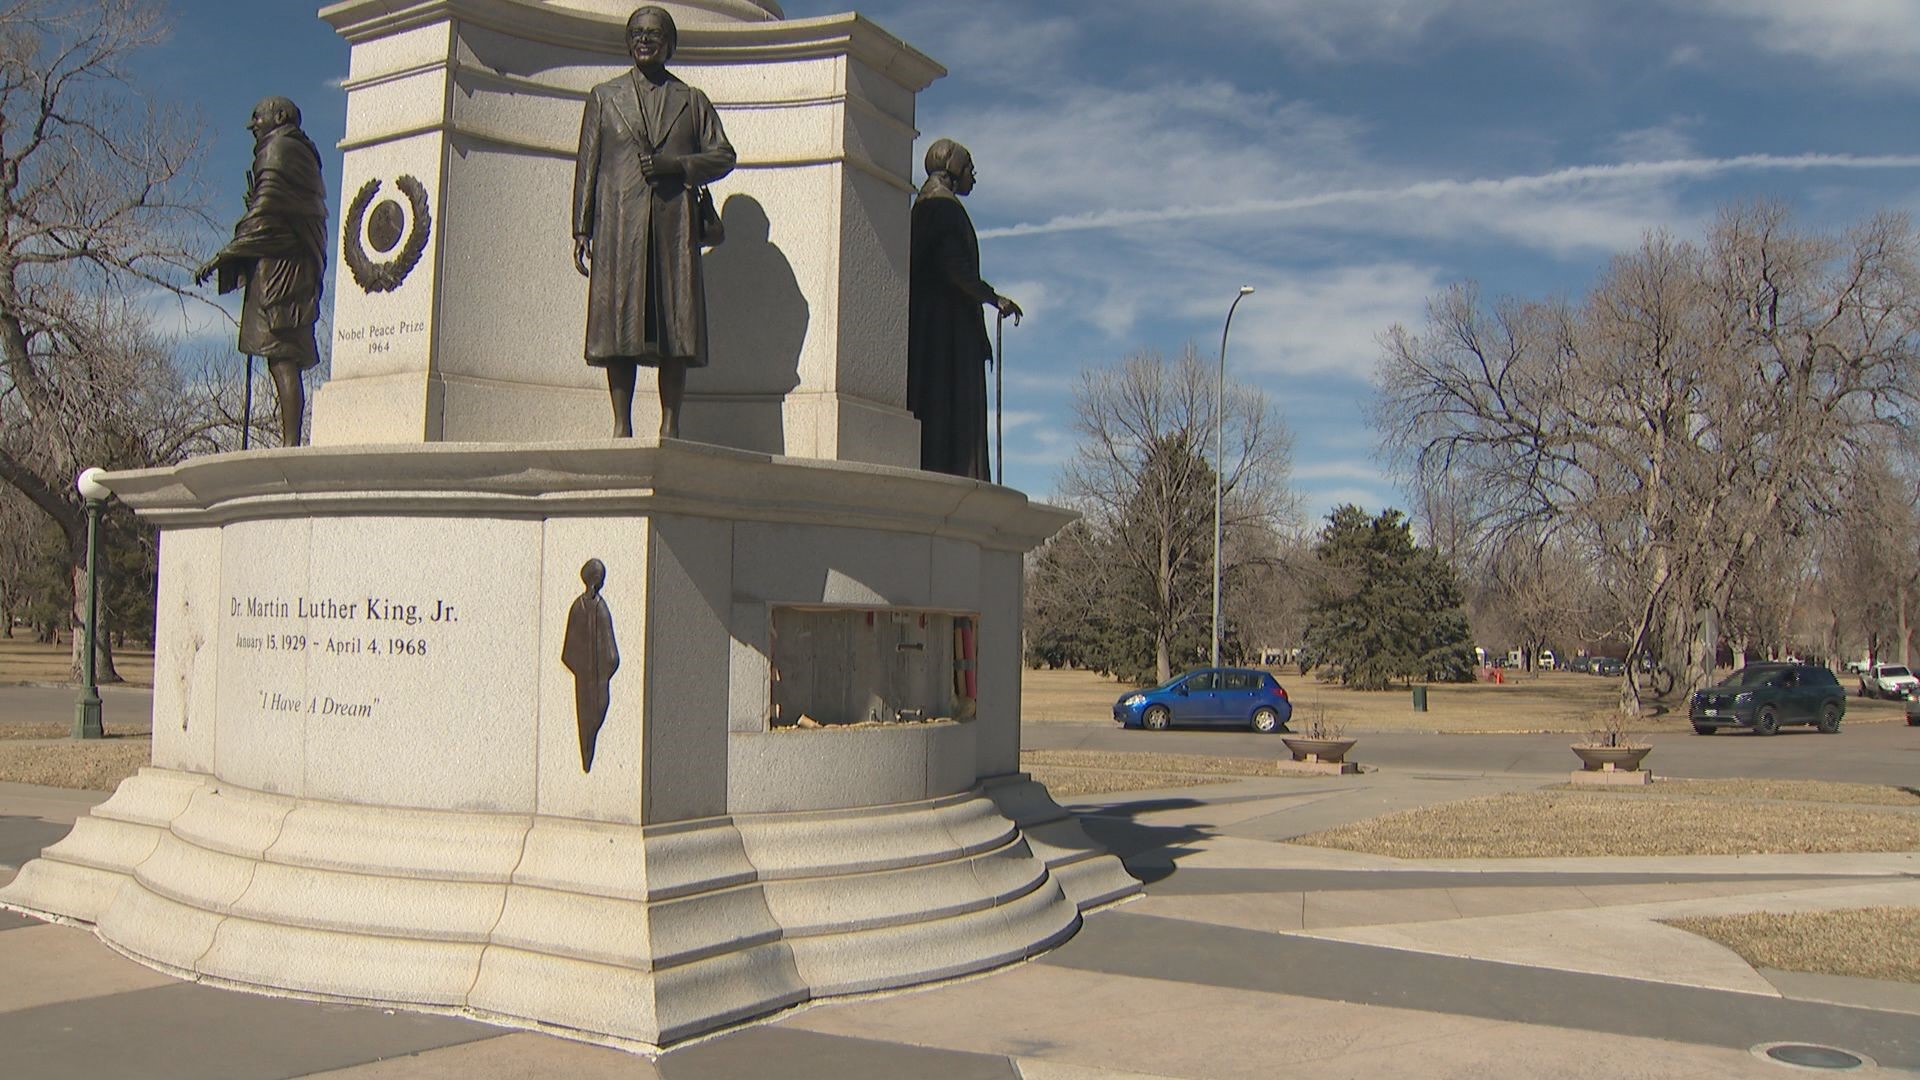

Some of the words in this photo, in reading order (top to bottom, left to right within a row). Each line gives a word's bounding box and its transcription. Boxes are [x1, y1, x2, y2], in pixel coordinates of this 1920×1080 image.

[337, 327, 365, 341] Nobel
[369, 325, 395, 338] Peace
[400, 320, 424, 334] Prize
[368, 342, 390, 354] 1964
[231, 596, 242, 617] Dr.
[247, 596, 289, 618] Martin
[298, 597, 357, 619] Luther
[367, 598, 423, 625] King,
[430, 599, 458, 622] Jr.
[236, 632, 263, 652] January
[266, 634, 278, 651] 15,
[282, 635, 307, 651] 1929
[326, 637, 361, 655] April
[367, 638, 381, 655] 4,
[389, 638, 427, 656] 1968
[271, 692, 301, 712] Have
[307, 696, 317, 713] A
[322, 696, 380, 717] Dream"
